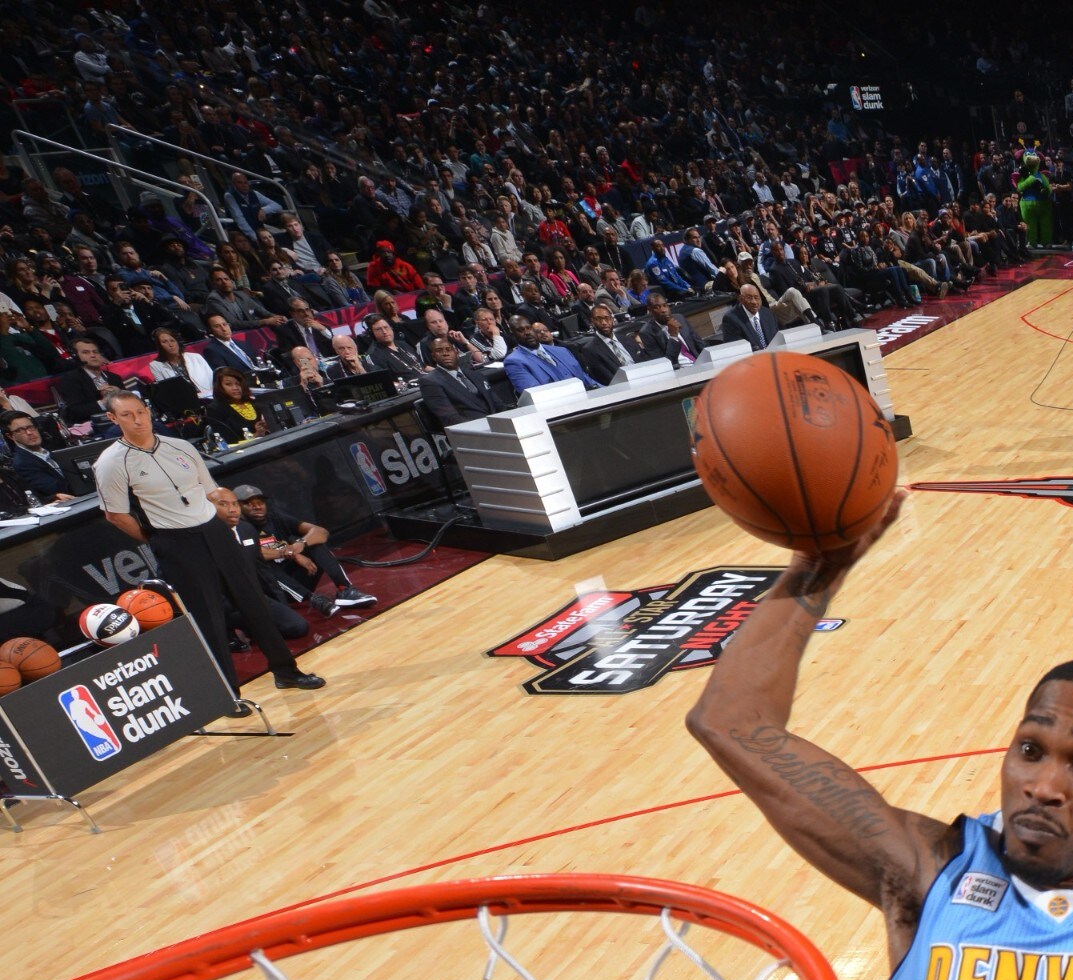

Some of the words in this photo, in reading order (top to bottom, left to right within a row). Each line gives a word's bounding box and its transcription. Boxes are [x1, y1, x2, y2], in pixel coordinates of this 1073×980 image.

[862, 92, 881, 100] slam
[863, 101, 884, 109] dunk
[623, 600, 680, 624] STAR
[568, 572, 768, 685] SATURDAY
[680, 601, 758, 649] NIGHT
[92, 652, 158, 691] verizon
[107, 673, 174, 717] slam
[122, 695, 191, 743] dunk
[92, 741, 113, 757] NBA
[966, 893, 994, 907] dunk
[971, 884, 997, 897] slam
